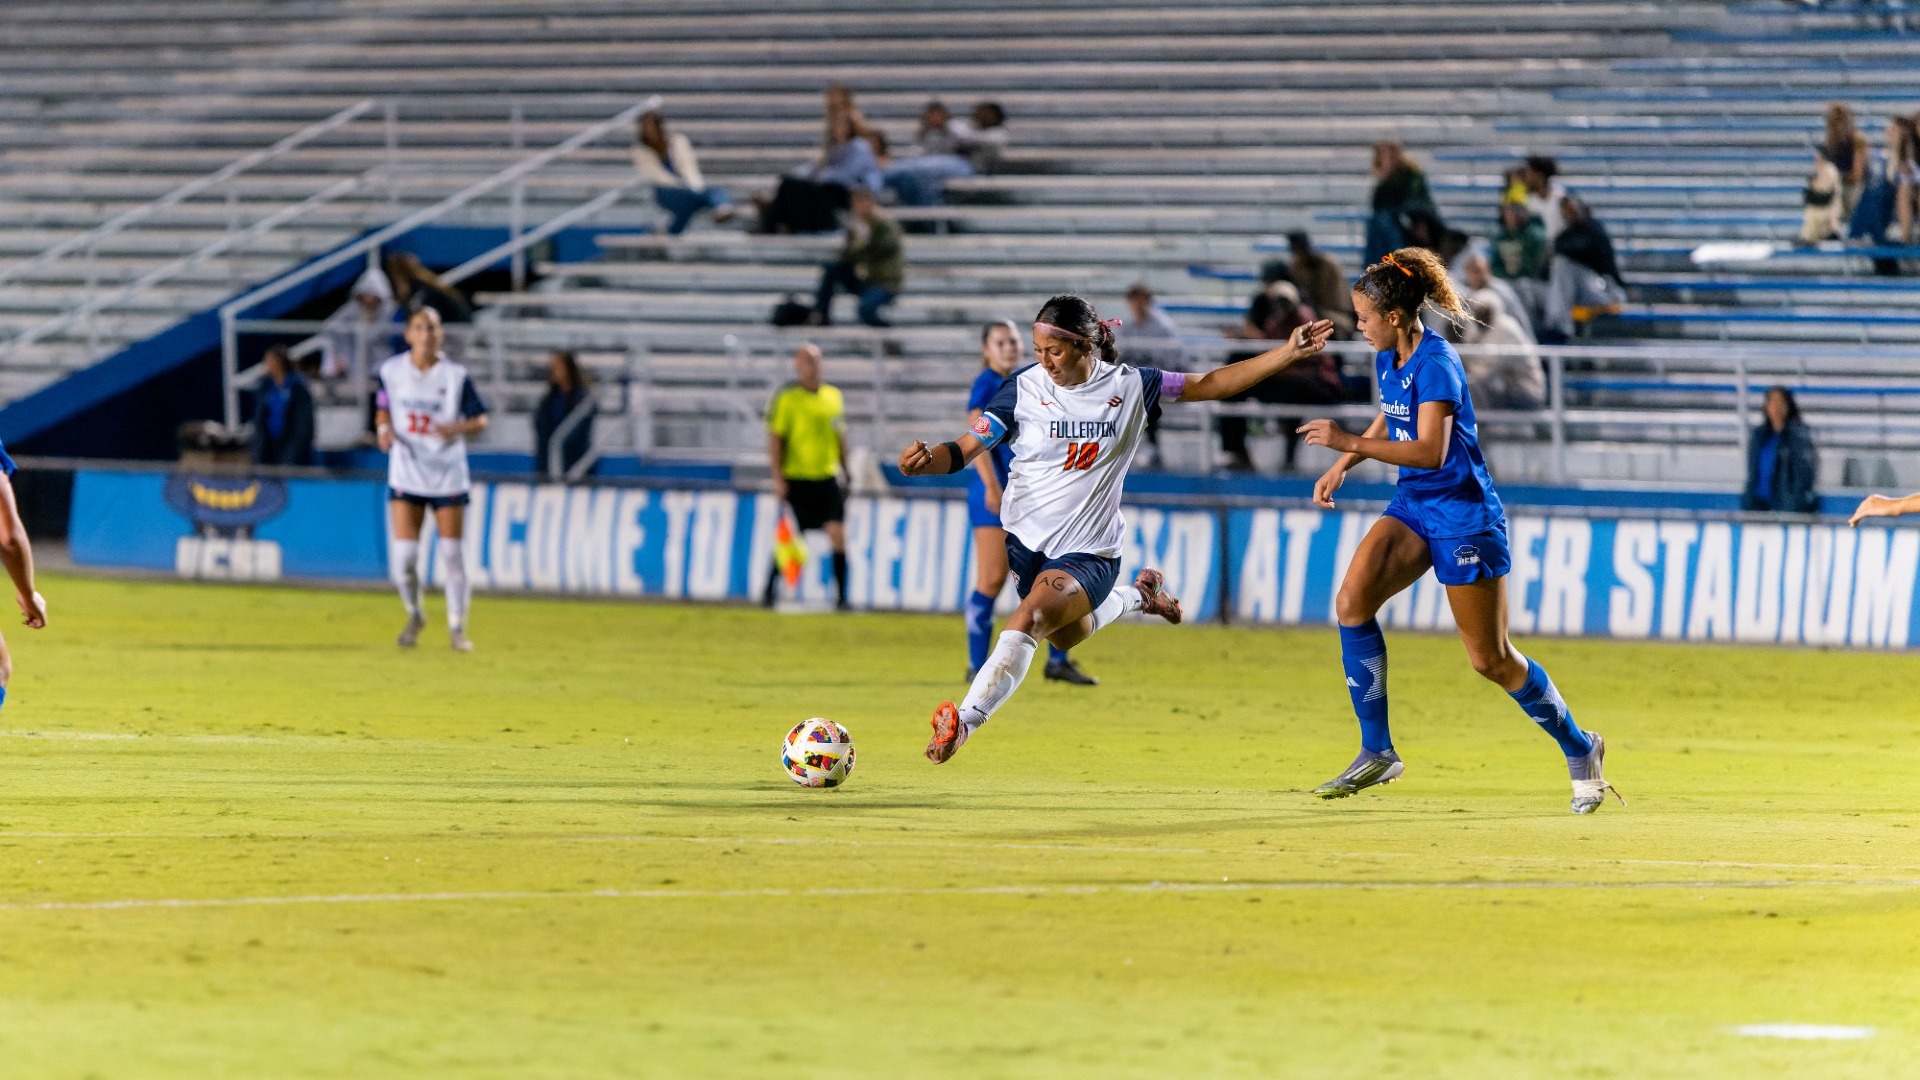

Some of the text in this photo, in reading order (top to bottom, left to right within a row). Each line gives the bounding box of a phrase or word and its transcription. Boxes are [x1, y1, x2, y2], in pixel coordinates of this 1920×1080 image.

[1380, 399, 1410, 416] auchos
[1049, 420, 1117, 439] FULLERTON
[1063, 442, 1100, 471] 10
[388, 482, 647, 592] LCOME
[662, 491, 738, 598] TO
[1238, 507, 1323, 625] AT
[1608, 517, 1919, 648] STADIUM
